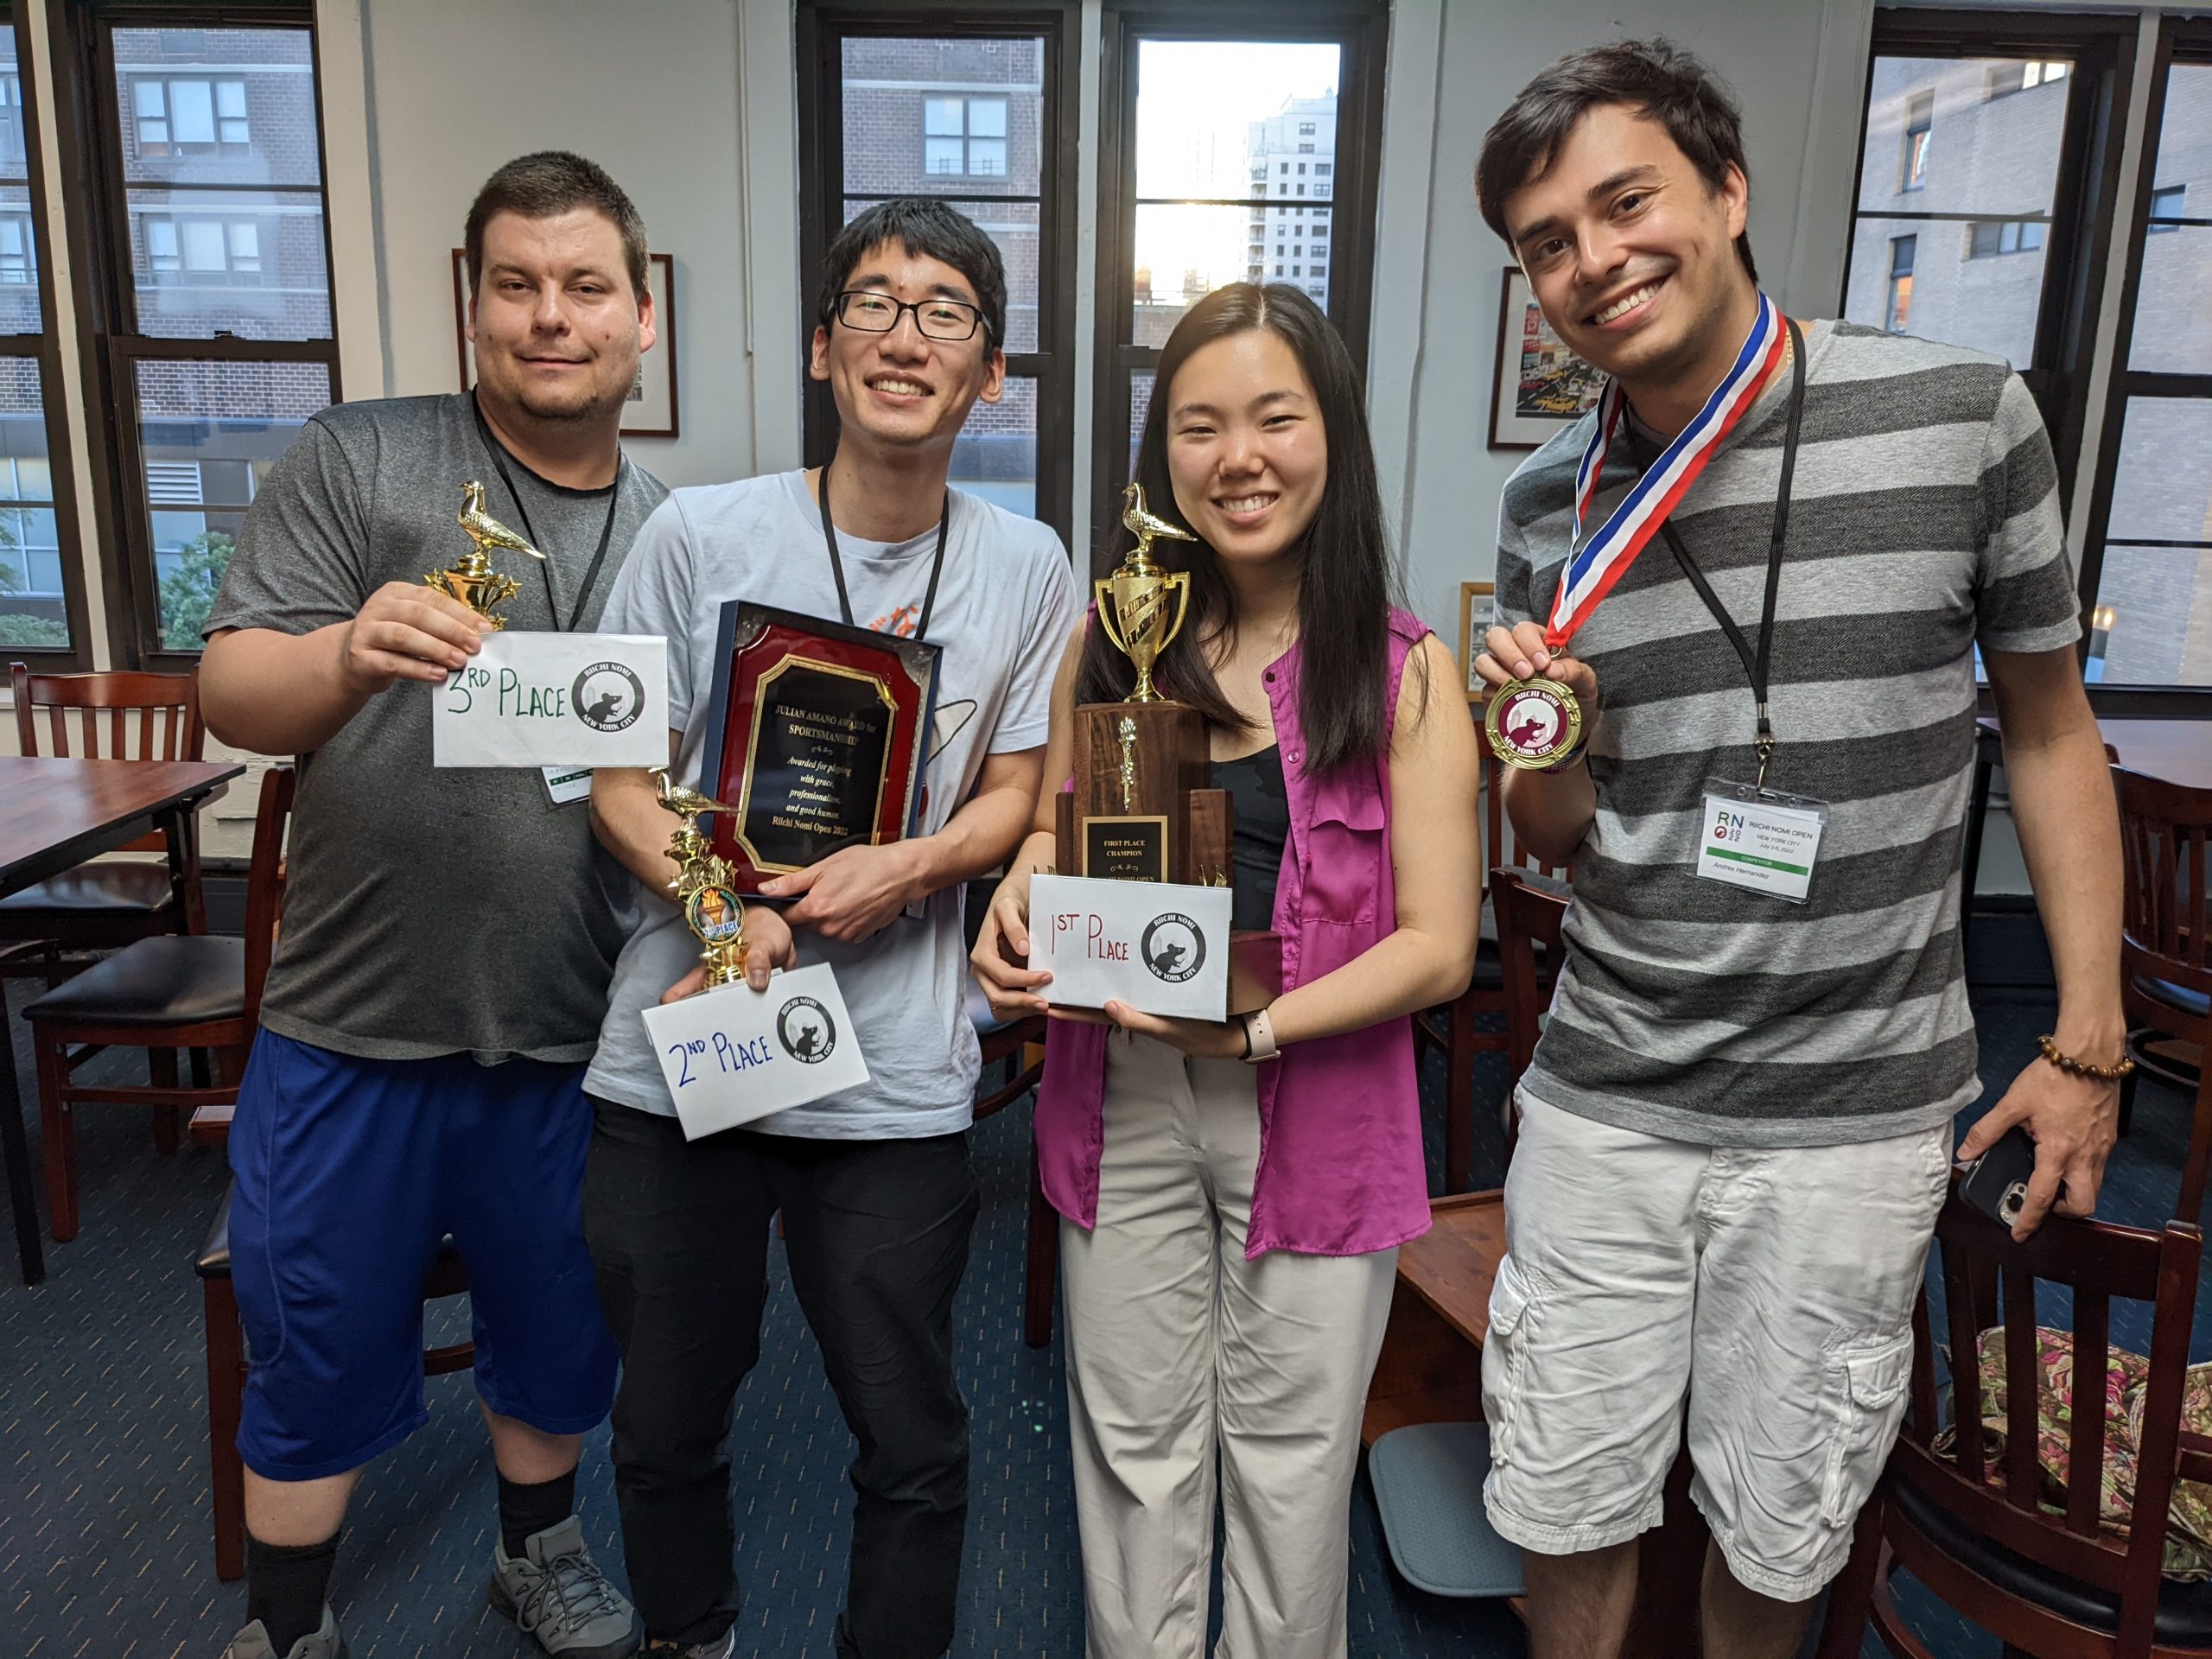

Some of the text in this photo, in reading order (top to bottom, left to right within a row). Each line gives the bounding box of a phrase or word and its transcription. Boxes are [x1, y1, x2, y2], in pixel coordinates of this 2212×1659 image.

[584, 664, 632, 677] RIICHI NOMI
[448, 667, 491, 713] 3RD
[1515, 690, 1560, 707] RIICHI NOMI
[582, 714, 598, 727] NEW
[620, 714, 635, 727] CITY
[775, 705, 806, 718] JULIAN
[806, 712, 837, 725] AMANO
[1503, 735, 1554, 755] NEW YORK CITY
[787, 756, 817, 769] Awarded
[816, 761, 827, 771] for
[800, 774, 814, 784] with
[799, 807, 817, 815] good
[772, 816, 849, 836] Riichi Nomi Open 2022
[1749, 821, 1813, 839] RIICHI NOMI OPEN
[1736, 867, 1770, 879] Hernandez
[716, 922, 737, 934] PLACE
[1153, 914, 1196, 929] RIICHI NOMI
[1052, 914, 1080, 955] 1ST
[1149, 963, 1196, 981] NEW YORK CITY
[781, 998, 817, 1016] RIICHI NOMI
[793, 1041, 833, 1062] NEW YORK CITY
[668, 1039, 706, 1087] 2ND
